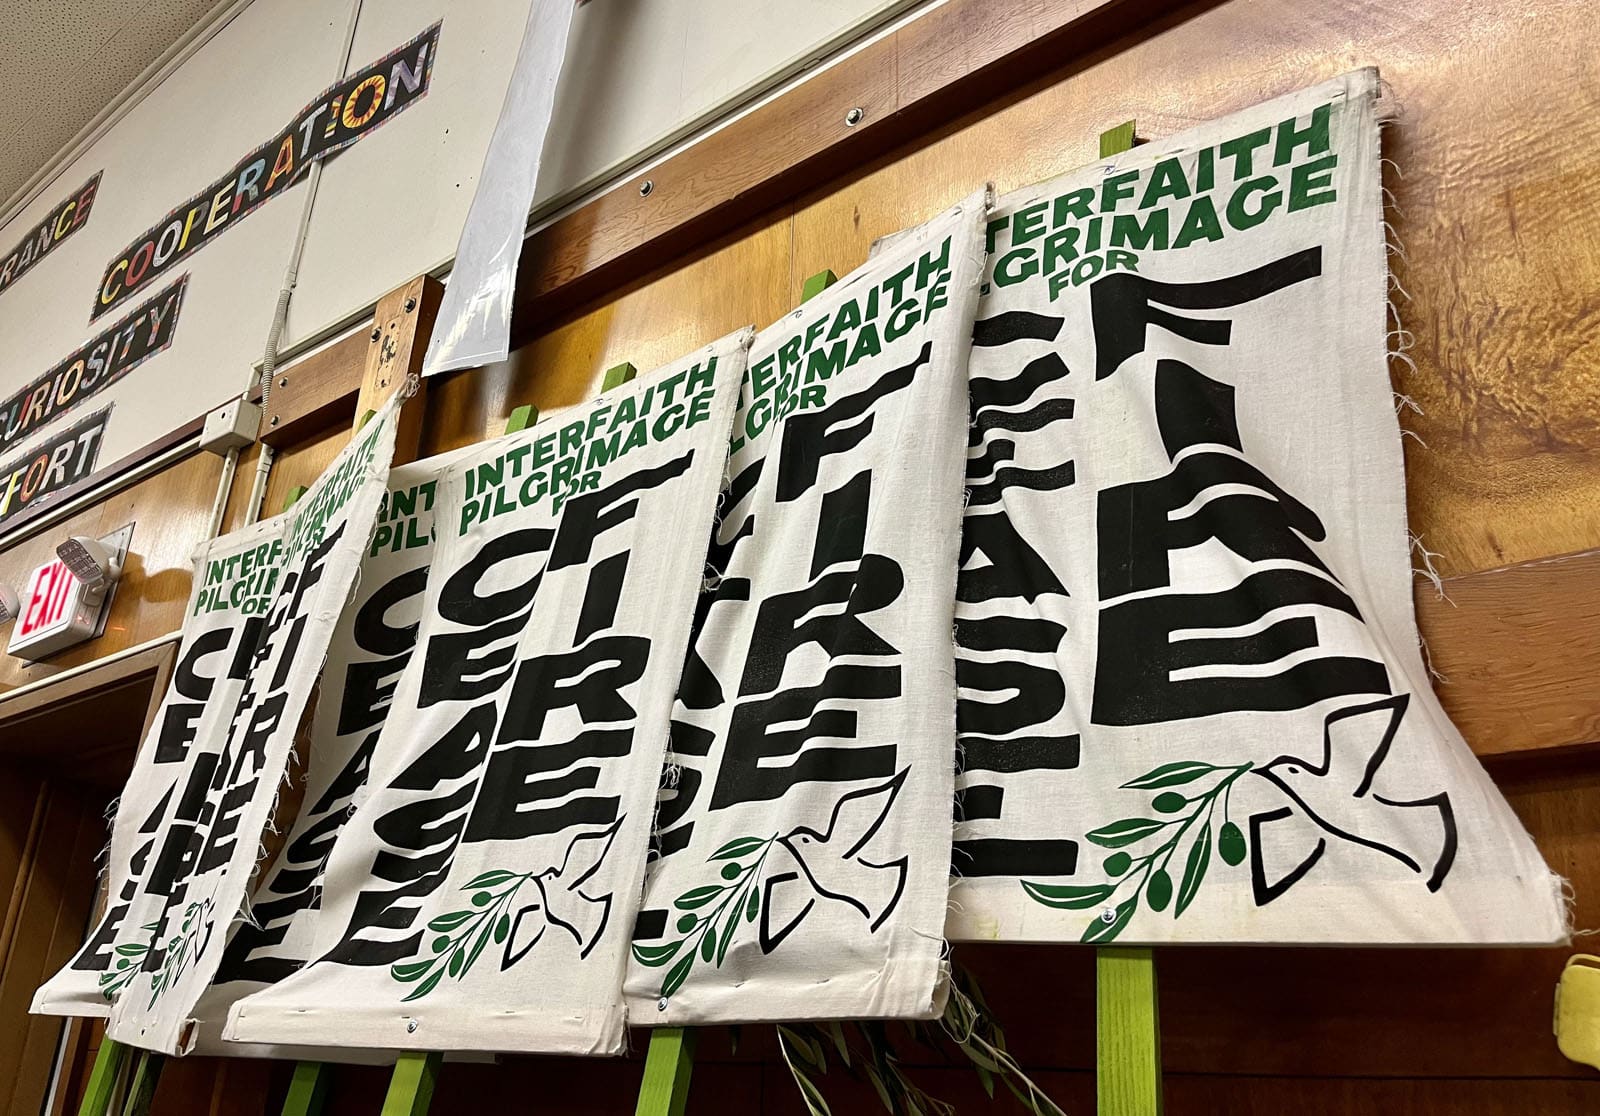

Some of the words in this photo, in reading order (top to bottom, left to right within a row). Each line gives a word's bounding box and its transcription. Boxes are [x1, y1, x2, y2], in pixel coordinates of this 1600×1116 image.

[101, 43, 429, 305] COOPERATION
[980, 154, 1338, 297] GRIMAGE
[1049, 250, 1140, 303] FOR
[459, 389, 715, 537] PILGRIMAGE
[465, 356, 719, 501] INTERFAITH
[370, 518, 440, 558] PIL
